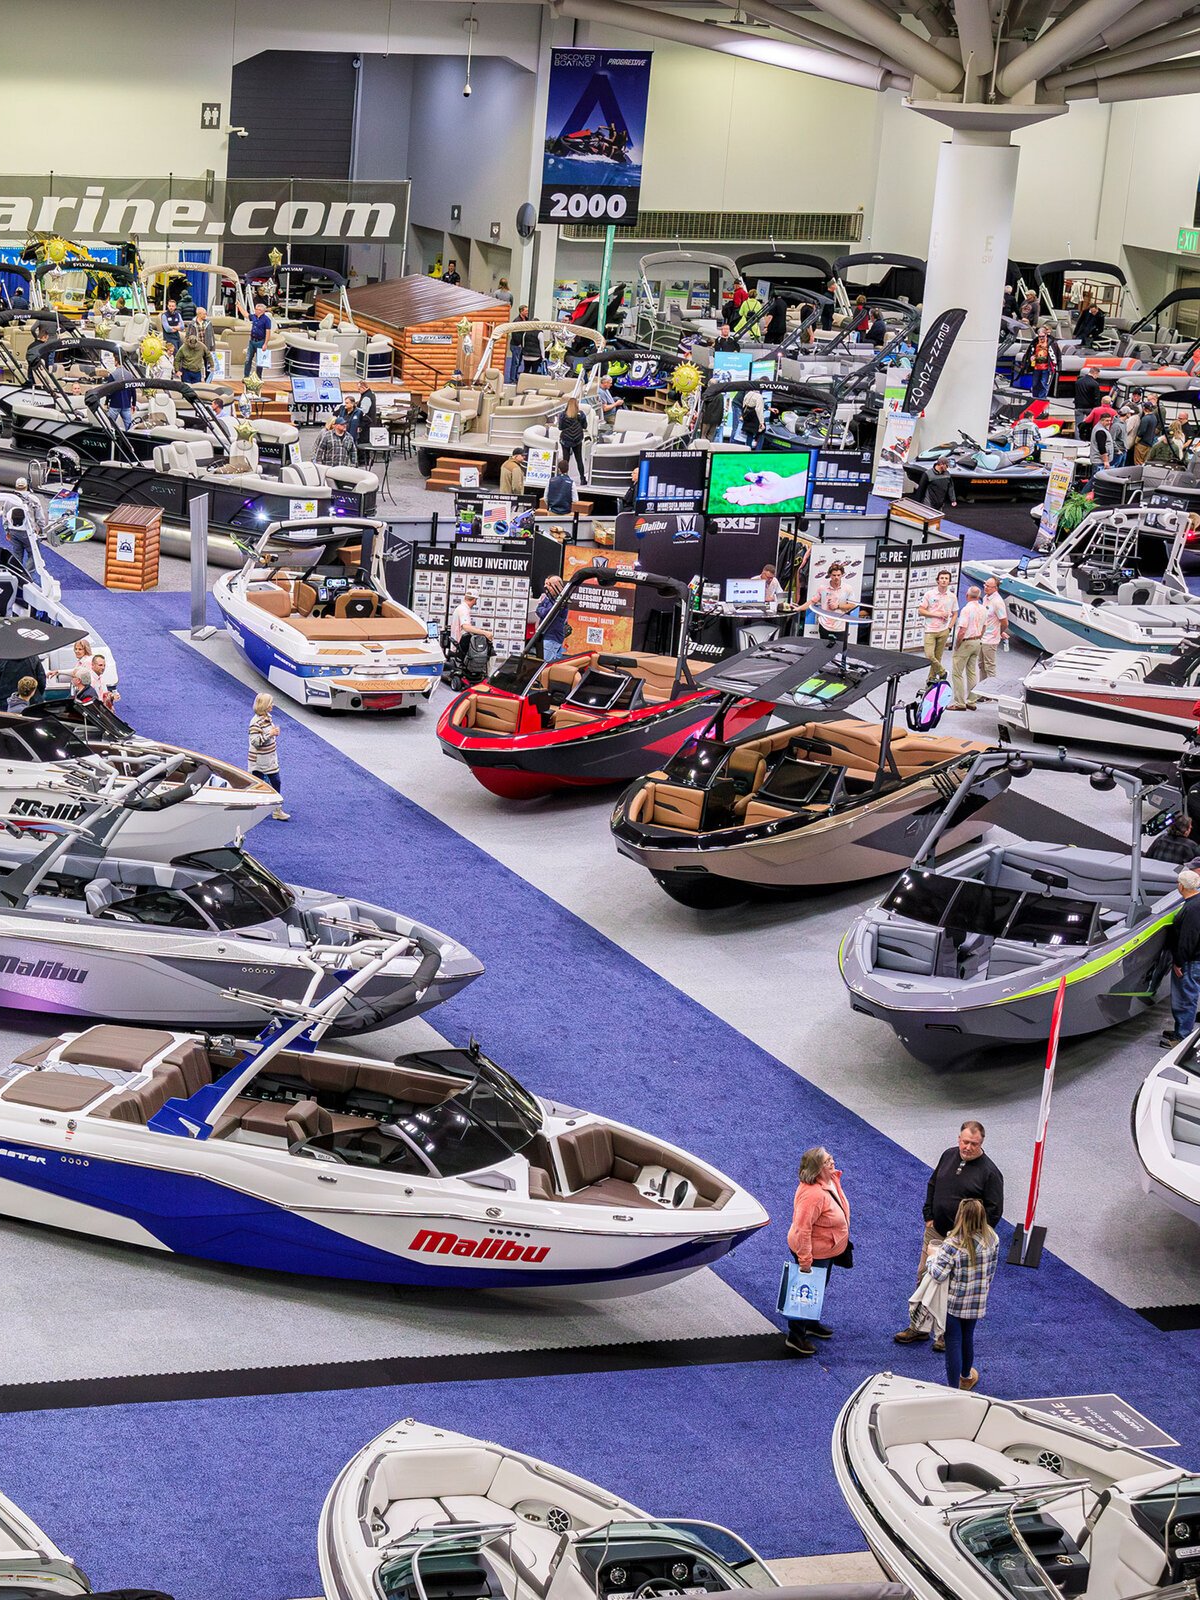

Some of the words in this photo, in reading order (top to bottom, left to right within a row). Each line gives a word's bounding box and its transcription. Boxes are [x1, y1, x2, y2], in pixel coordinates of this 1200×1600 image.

[554, 53, 596, 62] DISCOVER
[554, 59, 591, 67] BOATING
[606, 58, 647, 66] PROGRESSIVE
[550, 192, 627, 219] 2000
[1178, 228, 1200, 252] EXIT
[634, 353, 661, 361] SYLVAN
[909, 322, 950, 406] BENNINGTON
[759, 383, 789, 392] SYLVAN
[640, 521, 668, 532] Malibu
[428, 554, 449, 566] PRE-
[888, 550, 907, 563] PRE-
[911, 549, 930, 562] OWNED
[931, 546, 959, 560] INVENTORY
[453, 555, 483, 568] OWNED
[484, 558, 529, 572] INVENTORY
[578, 586, 602, 595] DETROIT
[602, 589, 619, 598] LAKES
[578, 601, 600, 610] SPRING
[600, 603, 617, 612] 2024!
[1008, 601, 1037, 625] AXIS
[686, 640, 725, 655] Malibu
[9, 797, 87, 821] Malib
[407, 1228, 552, 1264] Malibu
[1082, 1405, 1104, 1422] BOOTH
